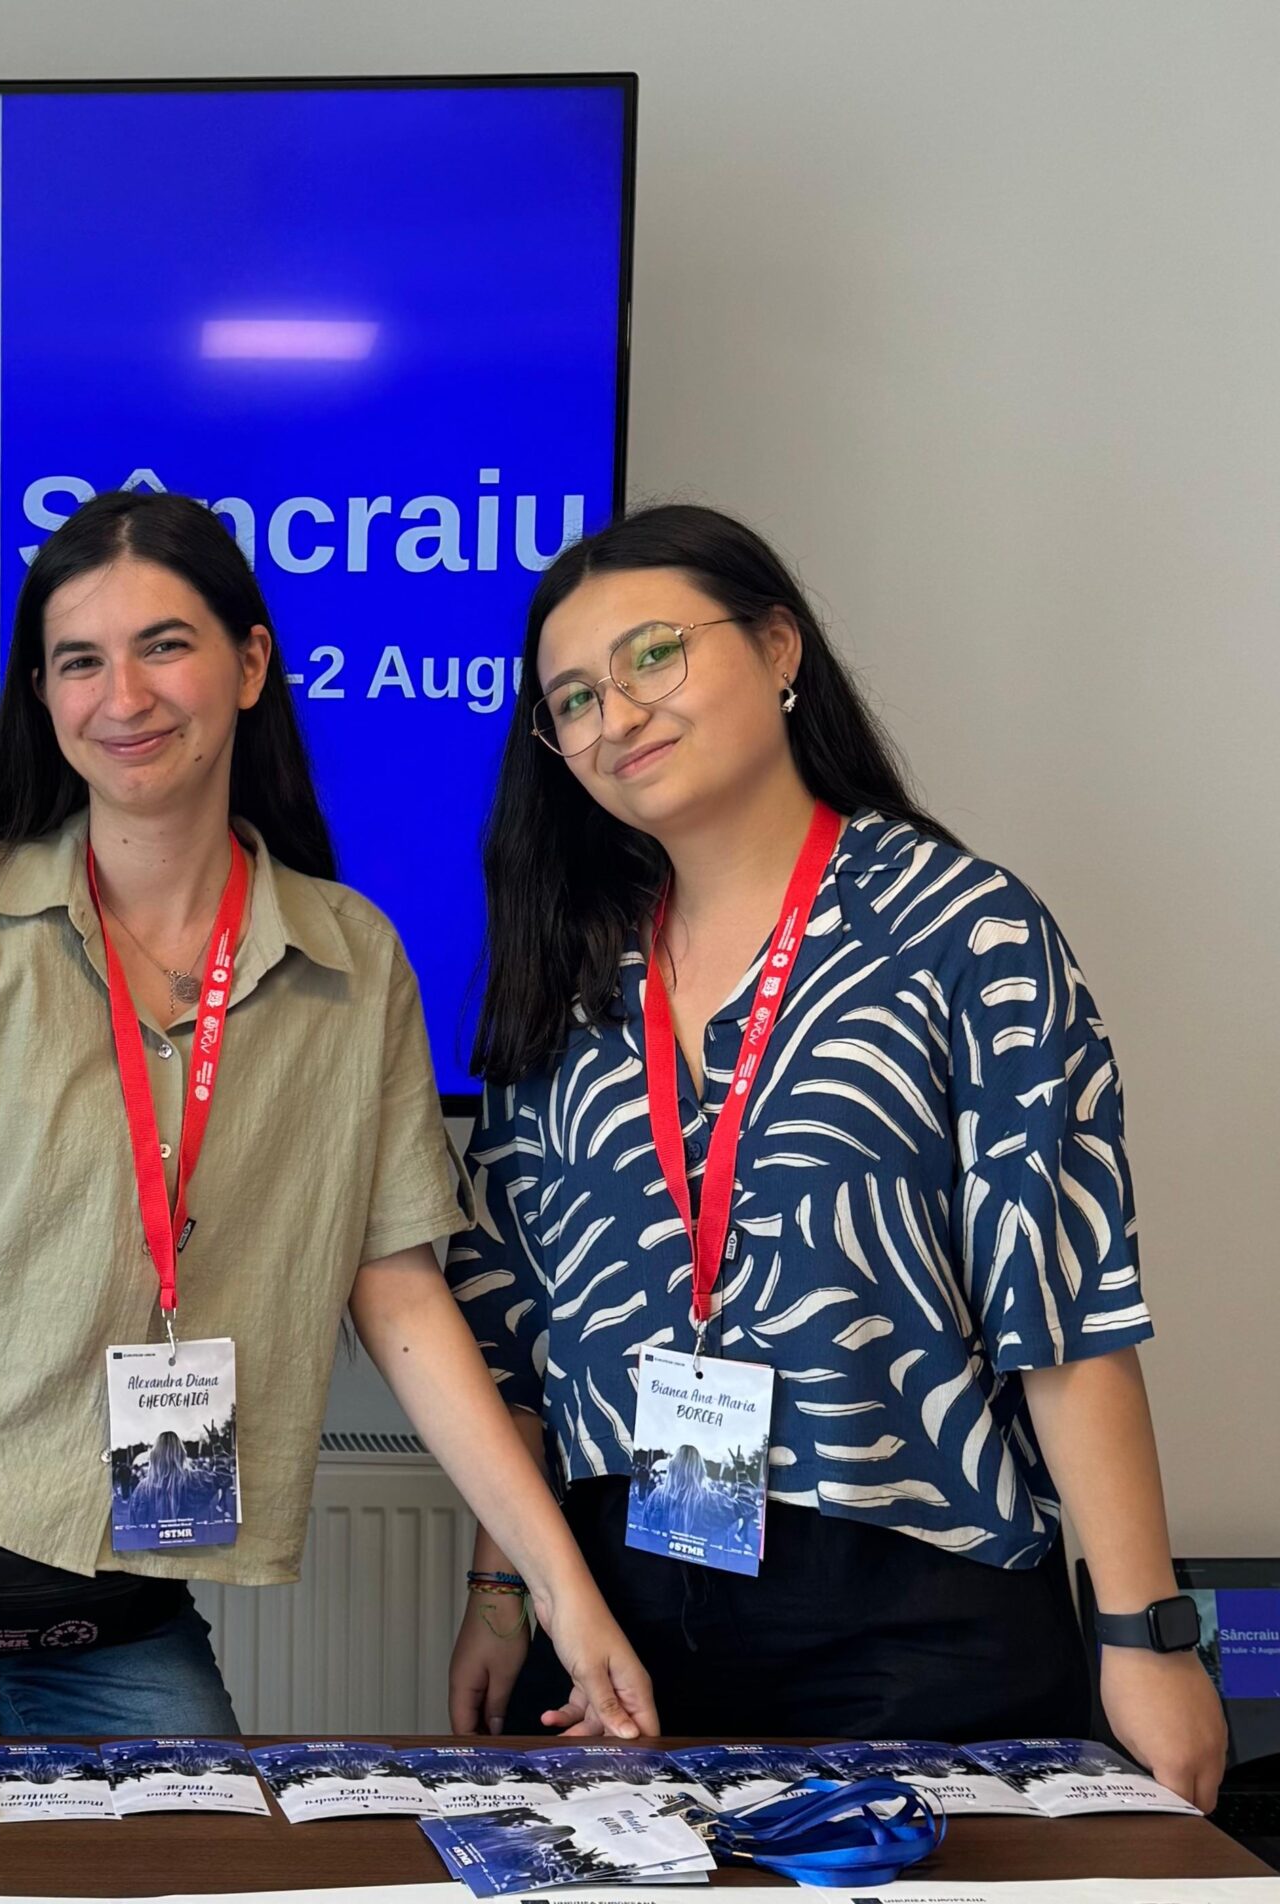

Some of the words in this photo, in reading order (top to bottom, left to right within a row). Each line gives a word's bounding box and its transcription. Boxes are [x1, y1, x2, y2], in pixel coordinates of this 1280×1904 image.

[128, 1373, 183, 1390] Alexandra
[185, 1373, 219, 1388] Diana
[651, 1379, 688, 1399] Bianca
[677, 1404, 723, 1427] BORCEA
